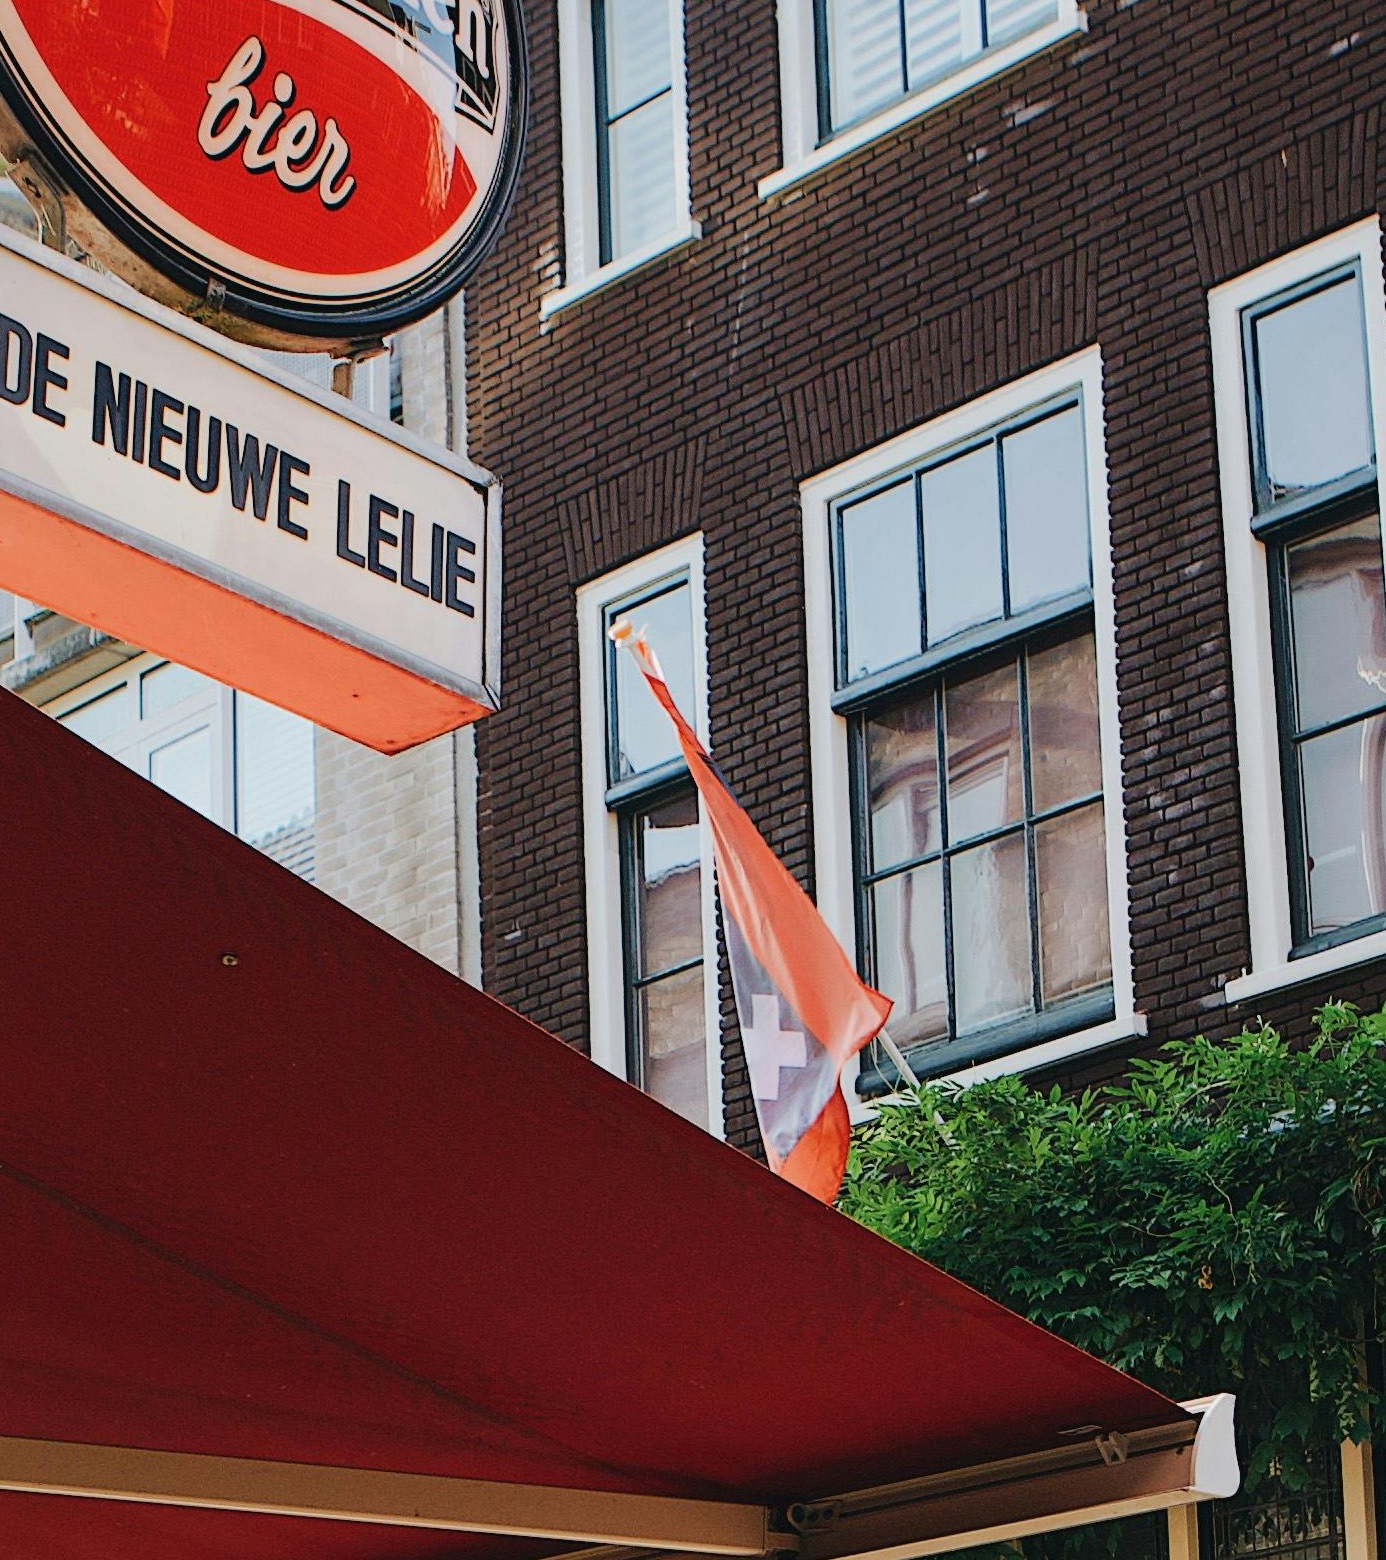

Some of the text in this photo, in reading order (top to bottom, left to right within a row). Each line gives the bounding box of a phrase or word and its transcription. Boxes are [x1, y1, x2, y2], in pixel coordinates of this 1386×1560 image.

[197, 35, 356, 209] bier
[91, 360, 311, 541] NIEUWE
[336, 478, 477, 619] LELIE
